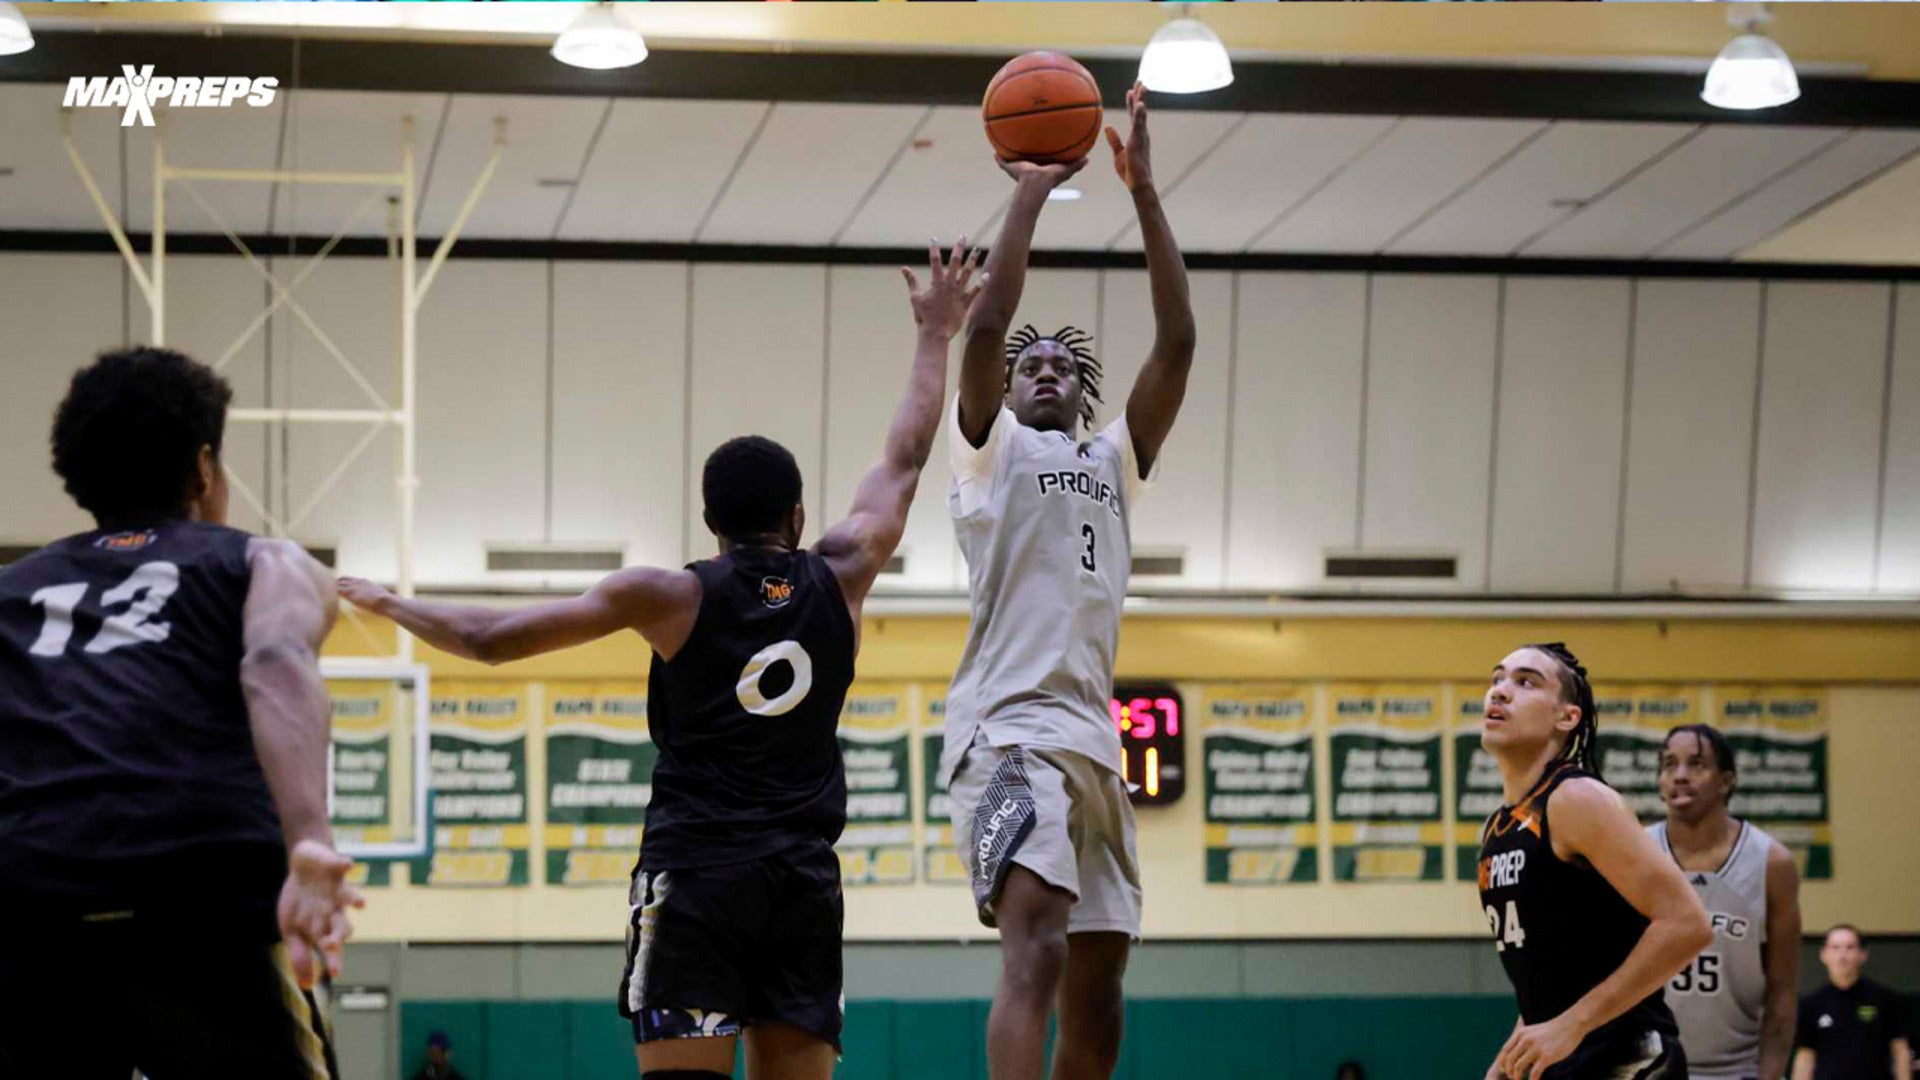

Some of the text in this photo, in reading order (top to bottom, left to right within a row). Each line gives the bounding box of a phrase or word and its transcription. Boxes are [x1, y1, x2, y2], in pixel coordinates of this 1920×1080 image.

[1080, 522, 1097, 573] 3
[28, 560, 180, 658] 12
[765, 582, 792, 600] TMG
[1672, 955, 1719, 992] 35
